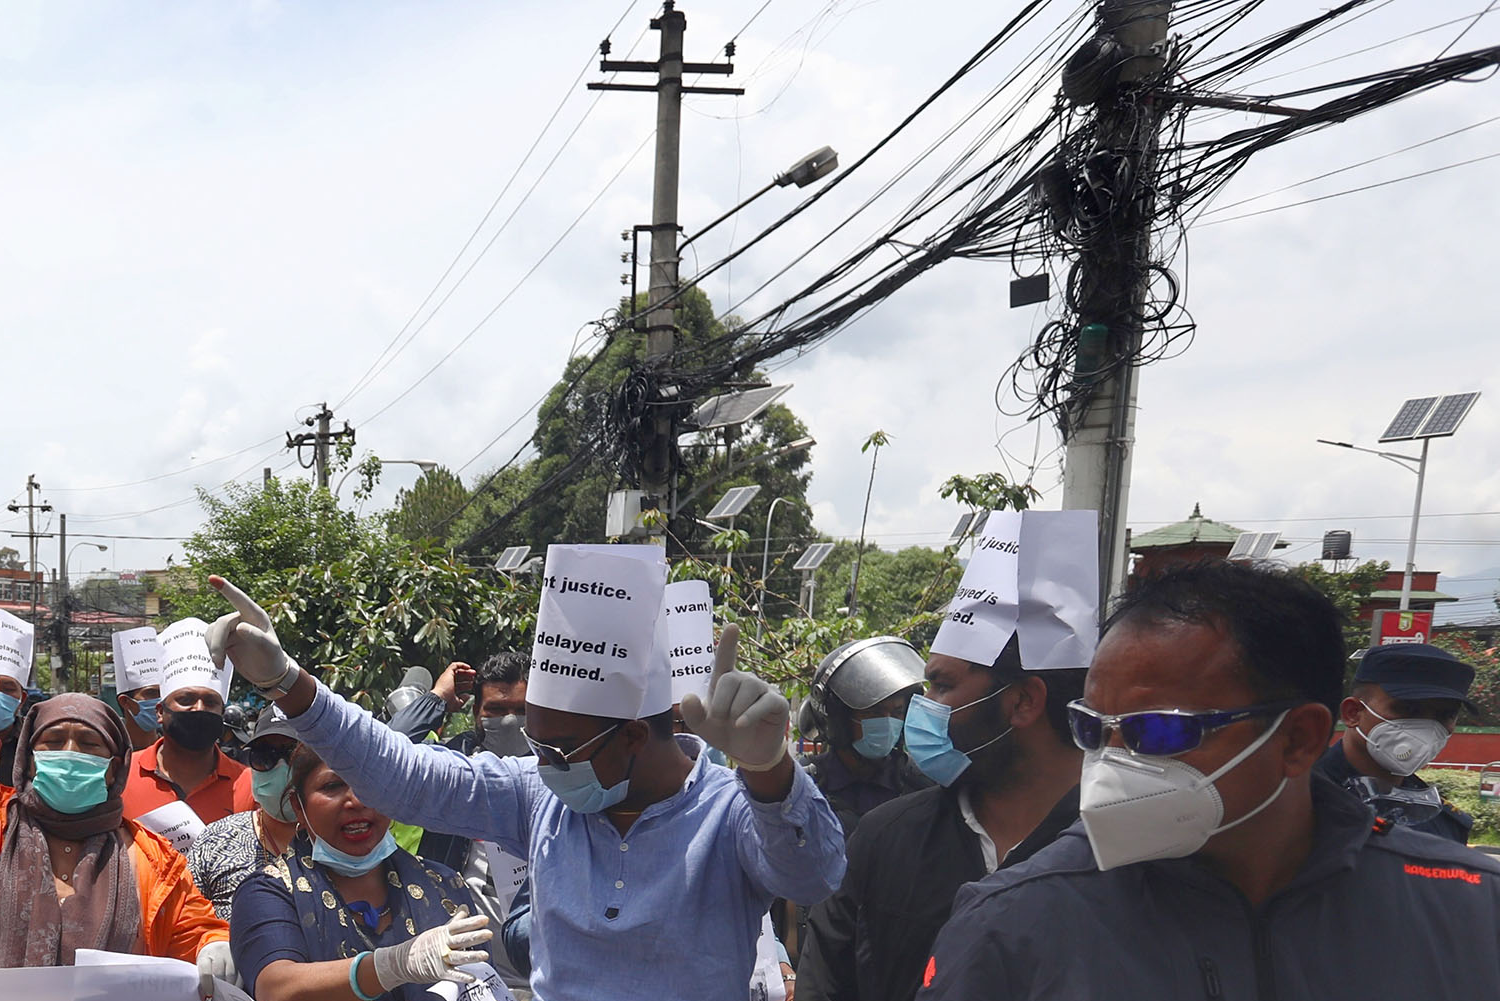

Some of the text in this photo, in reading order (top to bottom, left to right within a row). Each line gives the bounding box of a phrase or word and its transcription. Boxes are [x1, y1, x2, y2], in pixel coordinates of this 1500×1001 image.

[982, 537, 1019, 554] justic
[560, 577, 632, 601] justice.
[983, 592, 998, 605] is
[675, 602, 708, 614] want
[173, 630, 194, 640] want
[537, 631, 628, 659] delayed is
[132, 657, 156, 667] Justice
[186, 654, 212, 663] delay
[540, 659, 605, 682] denied.
